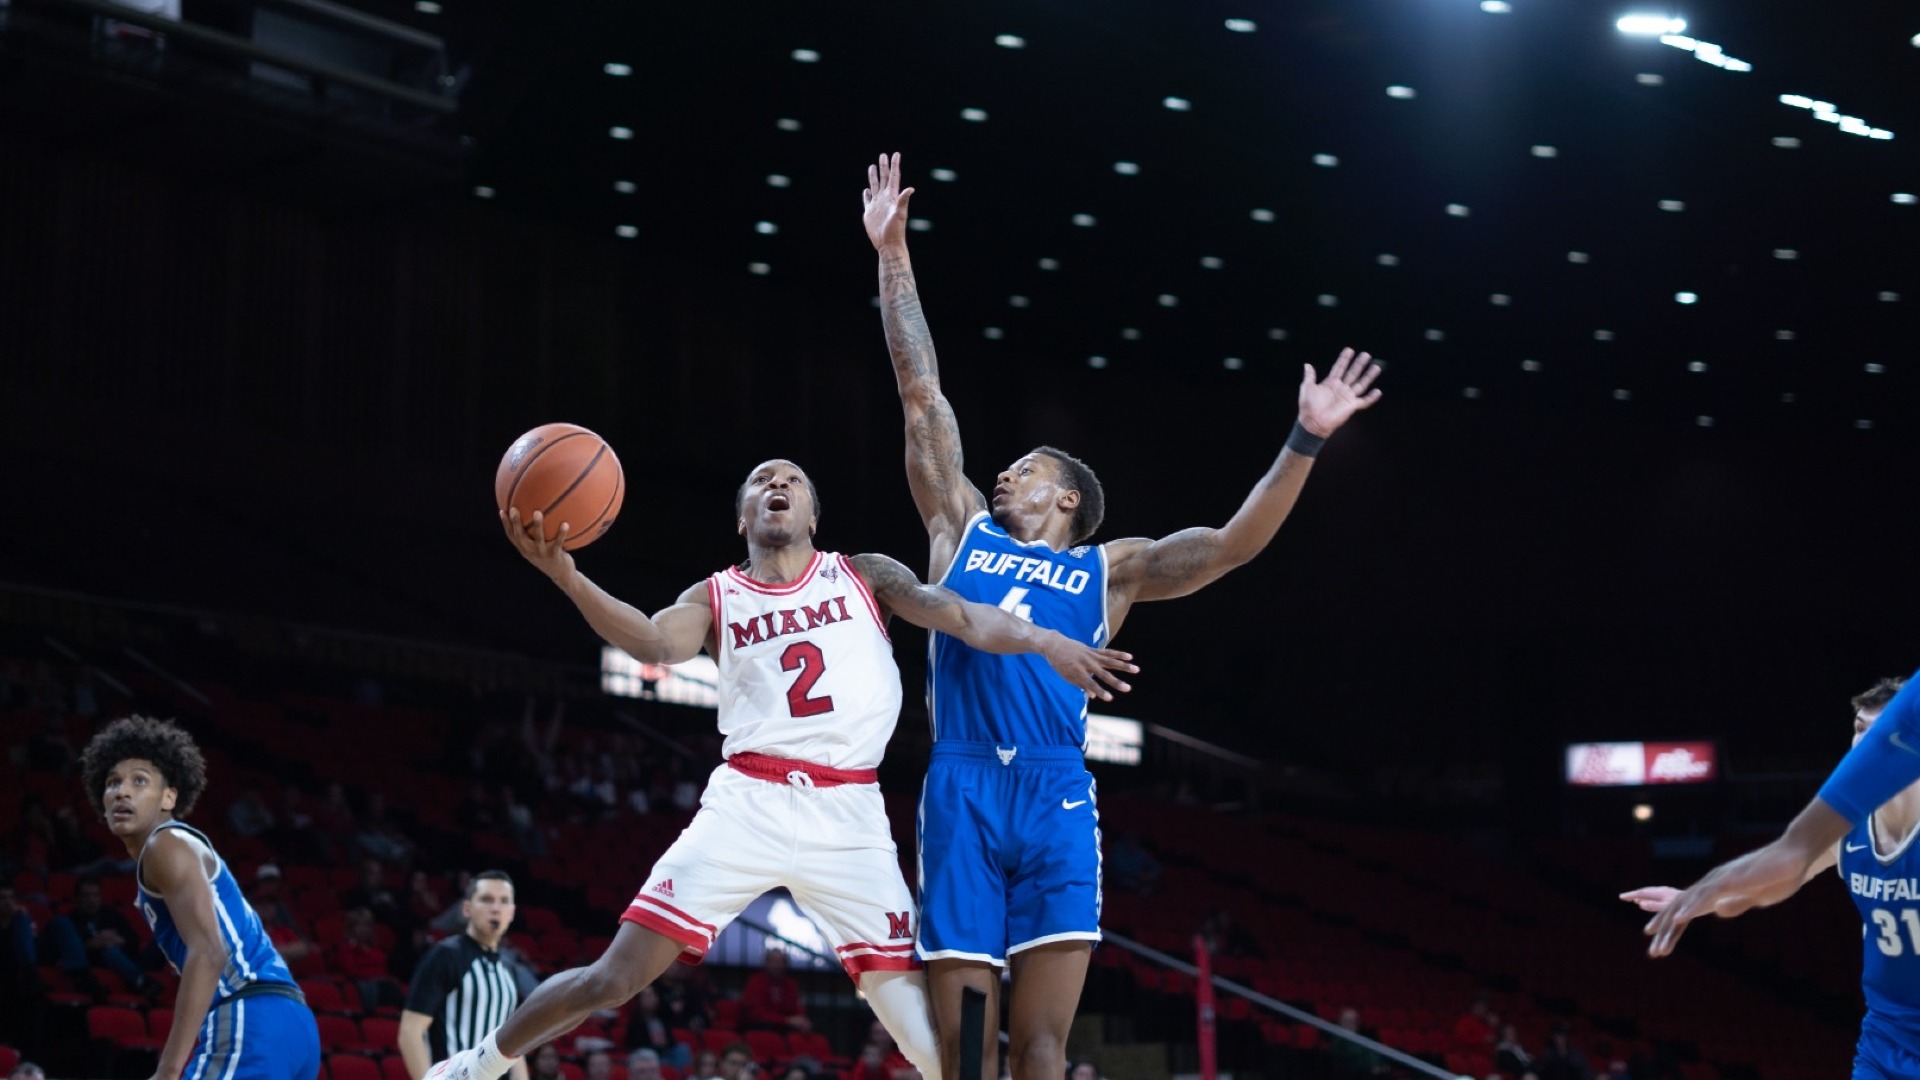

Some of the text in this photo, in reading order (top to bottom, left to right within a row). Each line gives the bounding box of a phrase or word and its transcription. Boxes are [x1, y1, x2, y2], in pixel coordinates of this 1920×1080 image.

[964, 549, 1090, 595] BUFFALO
[728, 596, 853, 650] MIAMI
[998, 586, 1033, 623] 4
[780, 640, 834, 718] 2
[885, 911, 913, 939] M
[1871, 908, 1920, 957] 31
